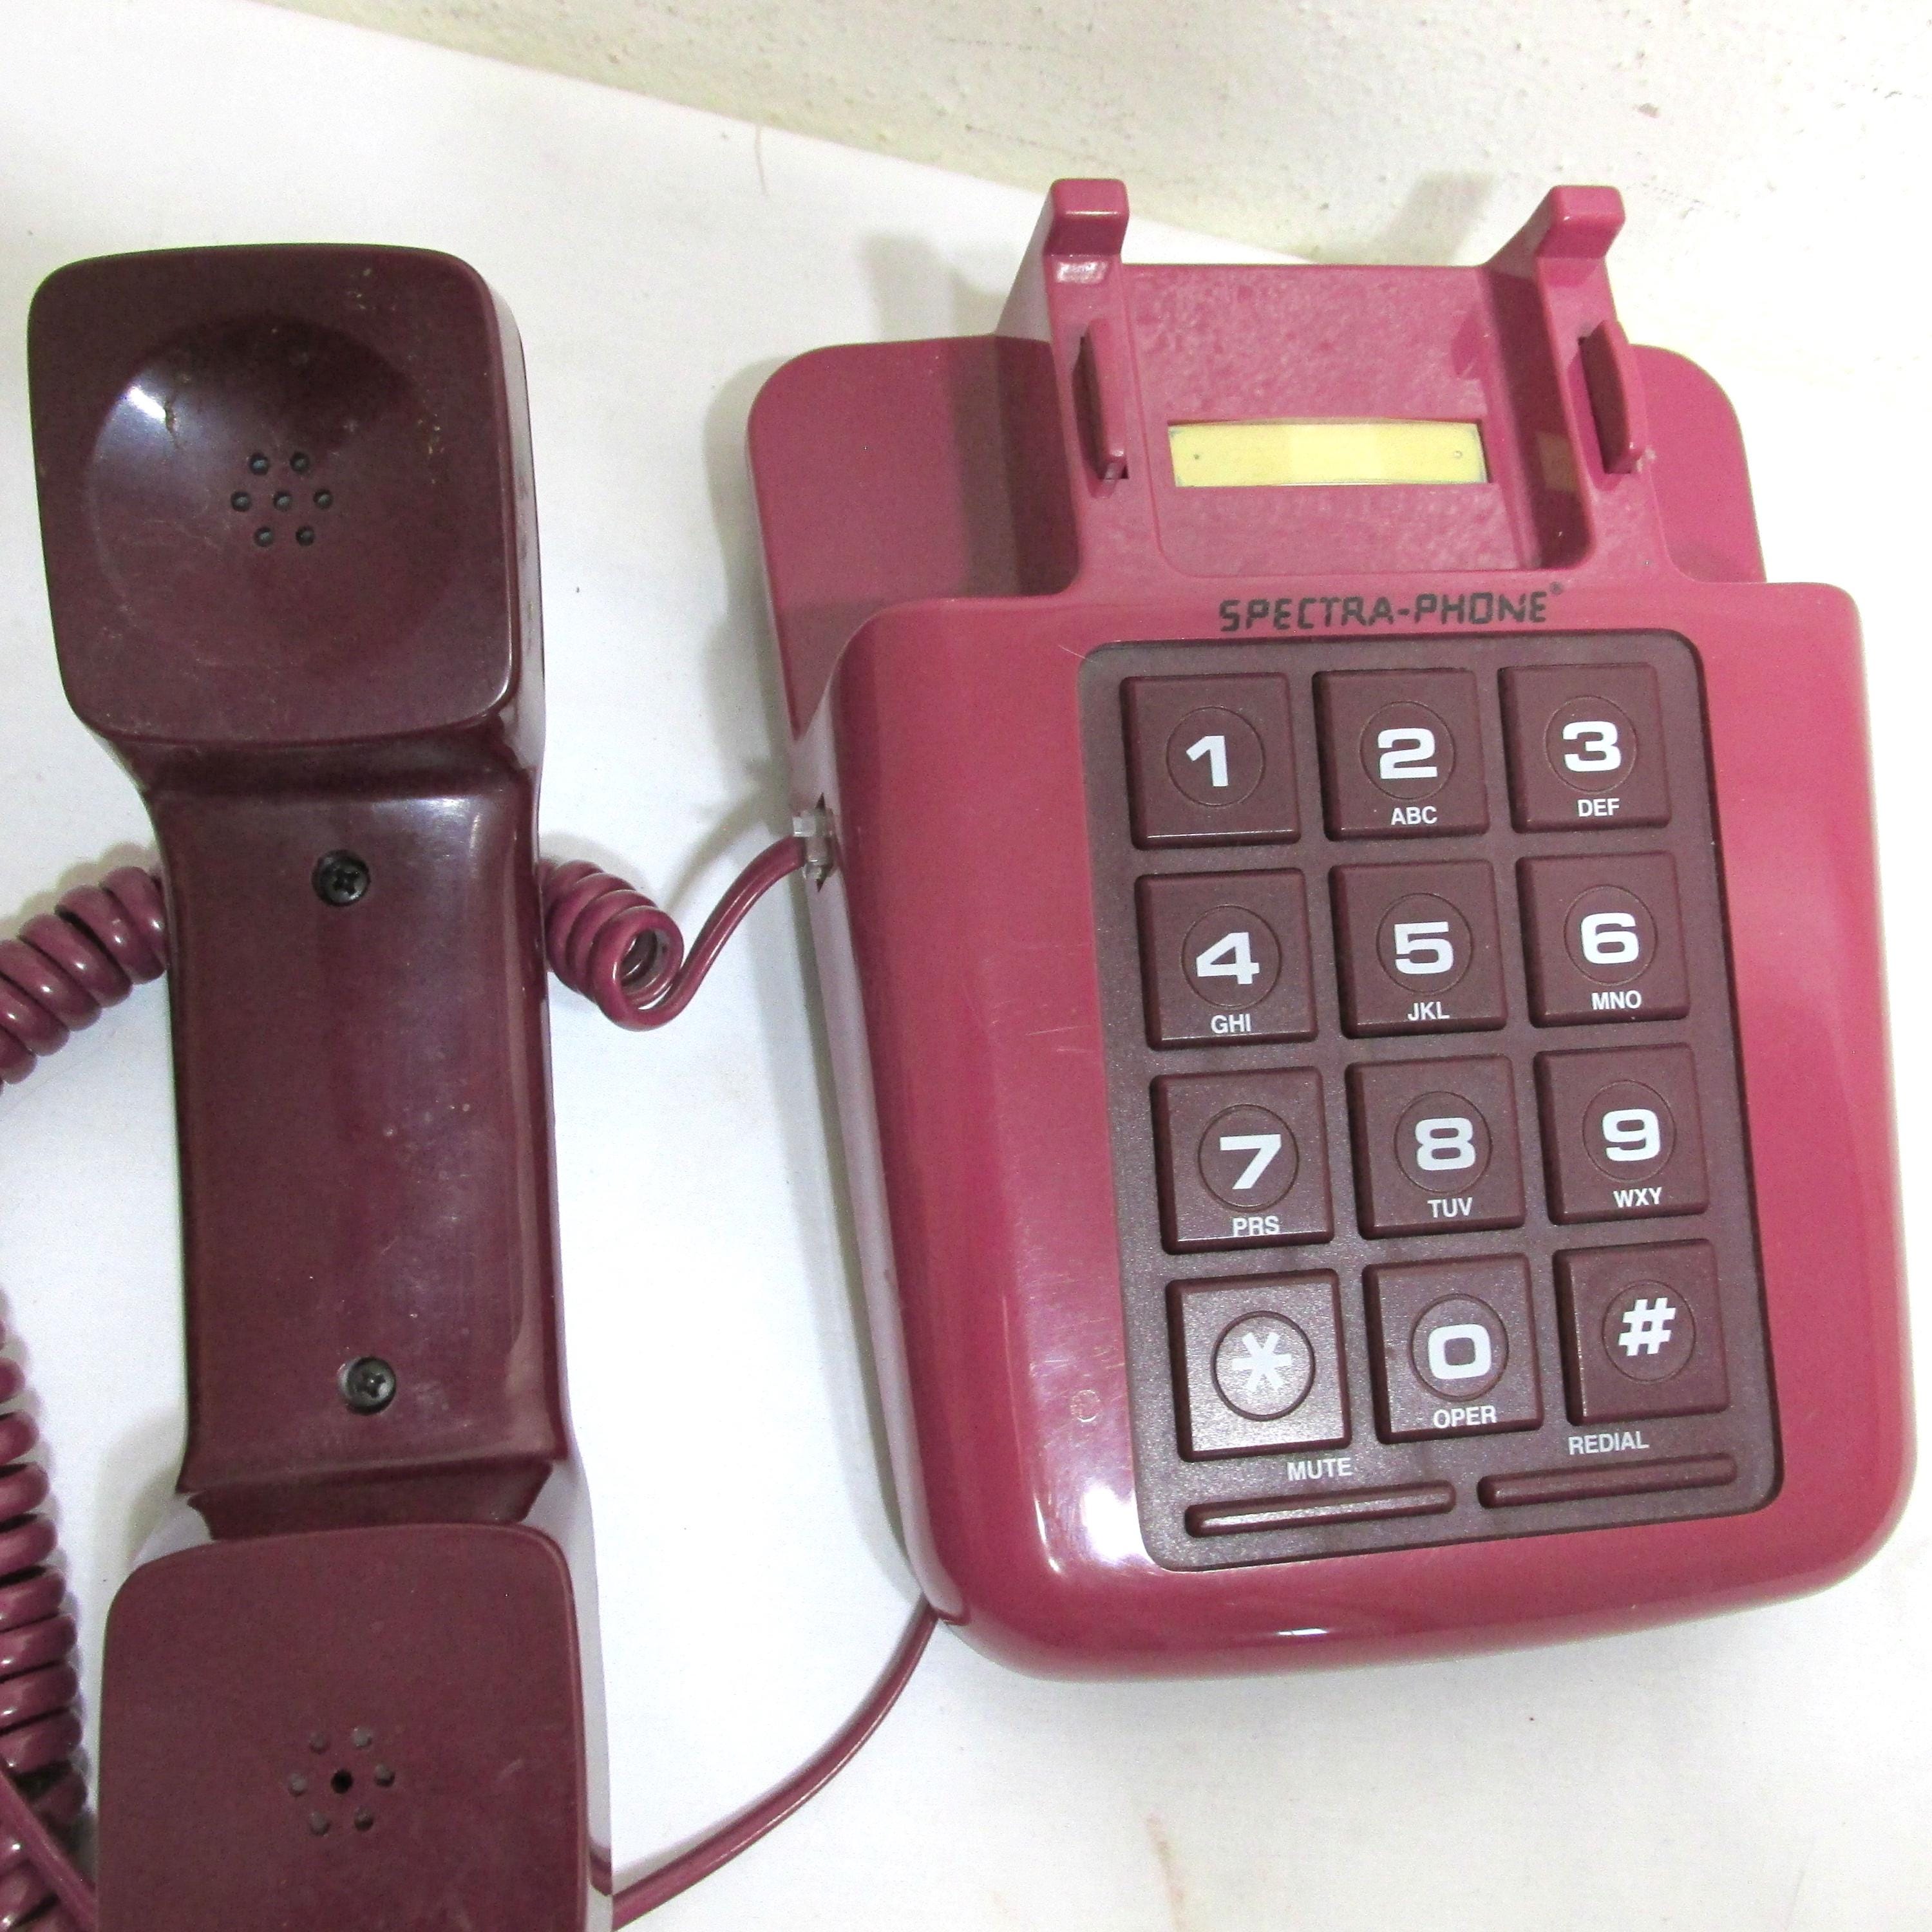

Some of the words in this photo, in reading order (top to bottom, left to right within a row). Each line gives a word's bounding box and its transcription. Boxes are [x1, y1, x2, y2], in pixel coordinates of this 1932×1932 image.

[1378, 728, 1438, 779] 2
[1562, 721, 1622, 772] 3
[1186, 735, 1229, 787] 1
[1390, 806, 1437, 826] ABC
[1577, 798, 1620, 817] DEF
[1394, 921, 1454, 974] 5
[1580, 912, 1640, 964] 6
[1196, 932, 1260, 985] 4
[1407, 1001, 1450, 1021] JKL
[1591, 990, 1642, 1010] MNO
[1210, 1013, 1252, 1034] GHI
[1415, 1117, 1476, 1171] 8
[1602, 1108, 1661, 1162] 9
[1220, 1133, 1282, 1190] 7
[1427, 1197, 1473, 1218] TUV
[1613, 1186, 1662, 1208] WXY
[1232, 1215, 1280, 1237] PRS
[1433, 1405, 1497, 1428] OPER
[1568, 1430, 1649, 1455] REDIAL
[1287, 1457, 1354, 1481] MUTE
